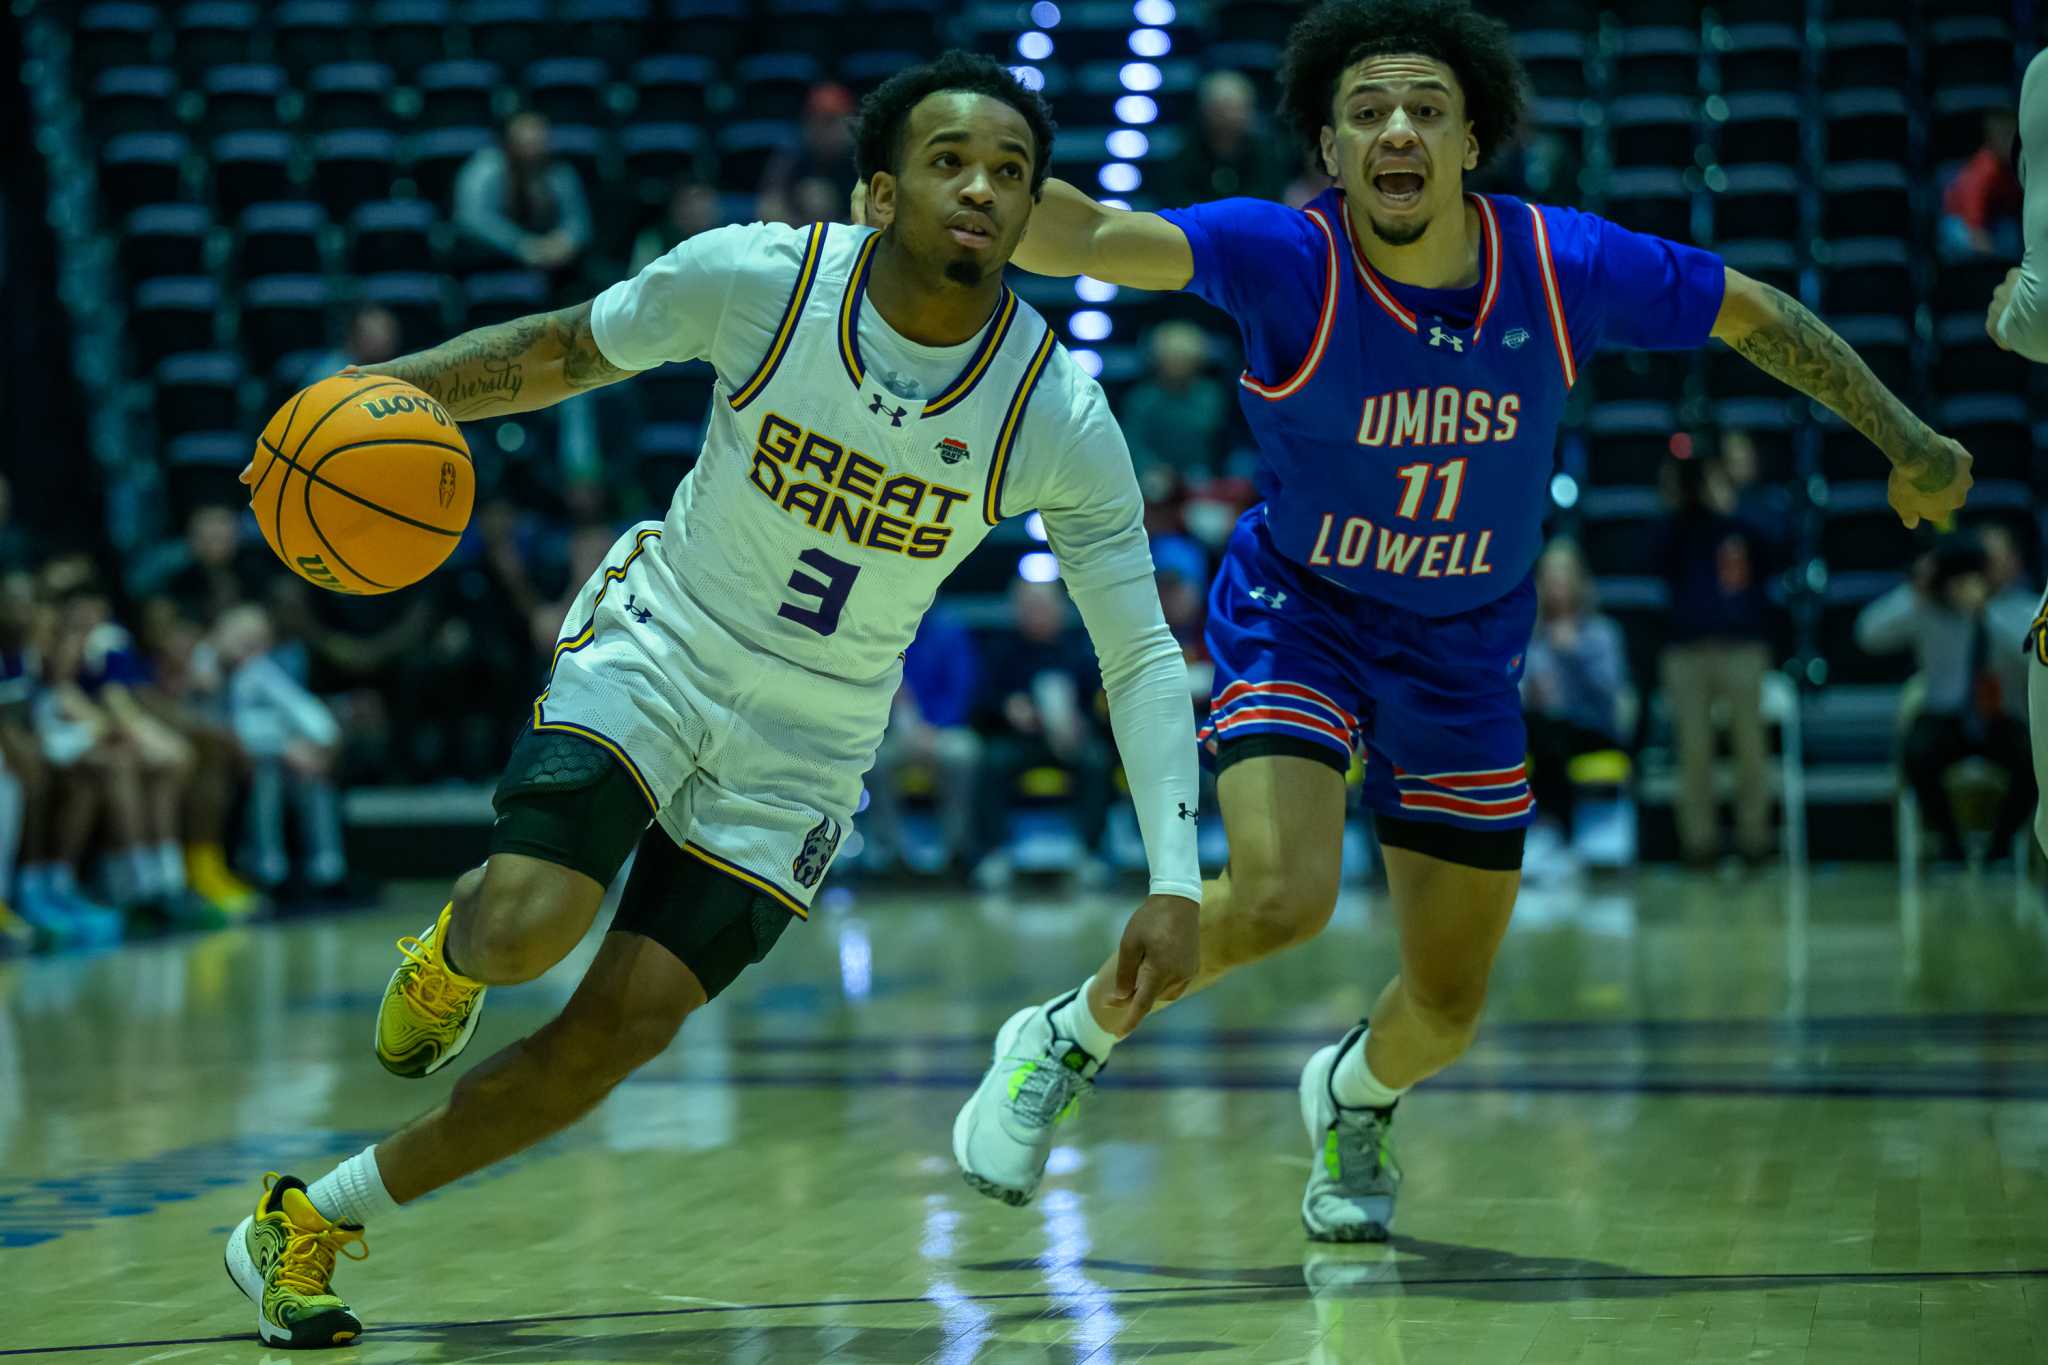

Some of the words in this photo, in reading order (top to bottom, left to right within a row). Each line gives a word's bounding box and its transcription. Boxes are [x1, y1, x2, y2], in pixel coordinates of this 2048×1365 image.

[1357, 386, 1521, 447] UMASS
[750, 448, 953, 560] DANES
[757, 411, 971, 524] GREAT
[1396, 457, 1468, 521] 11
[1309, 512, 1493, 579] LOWELL
[777, 547, 861, 637] 3
